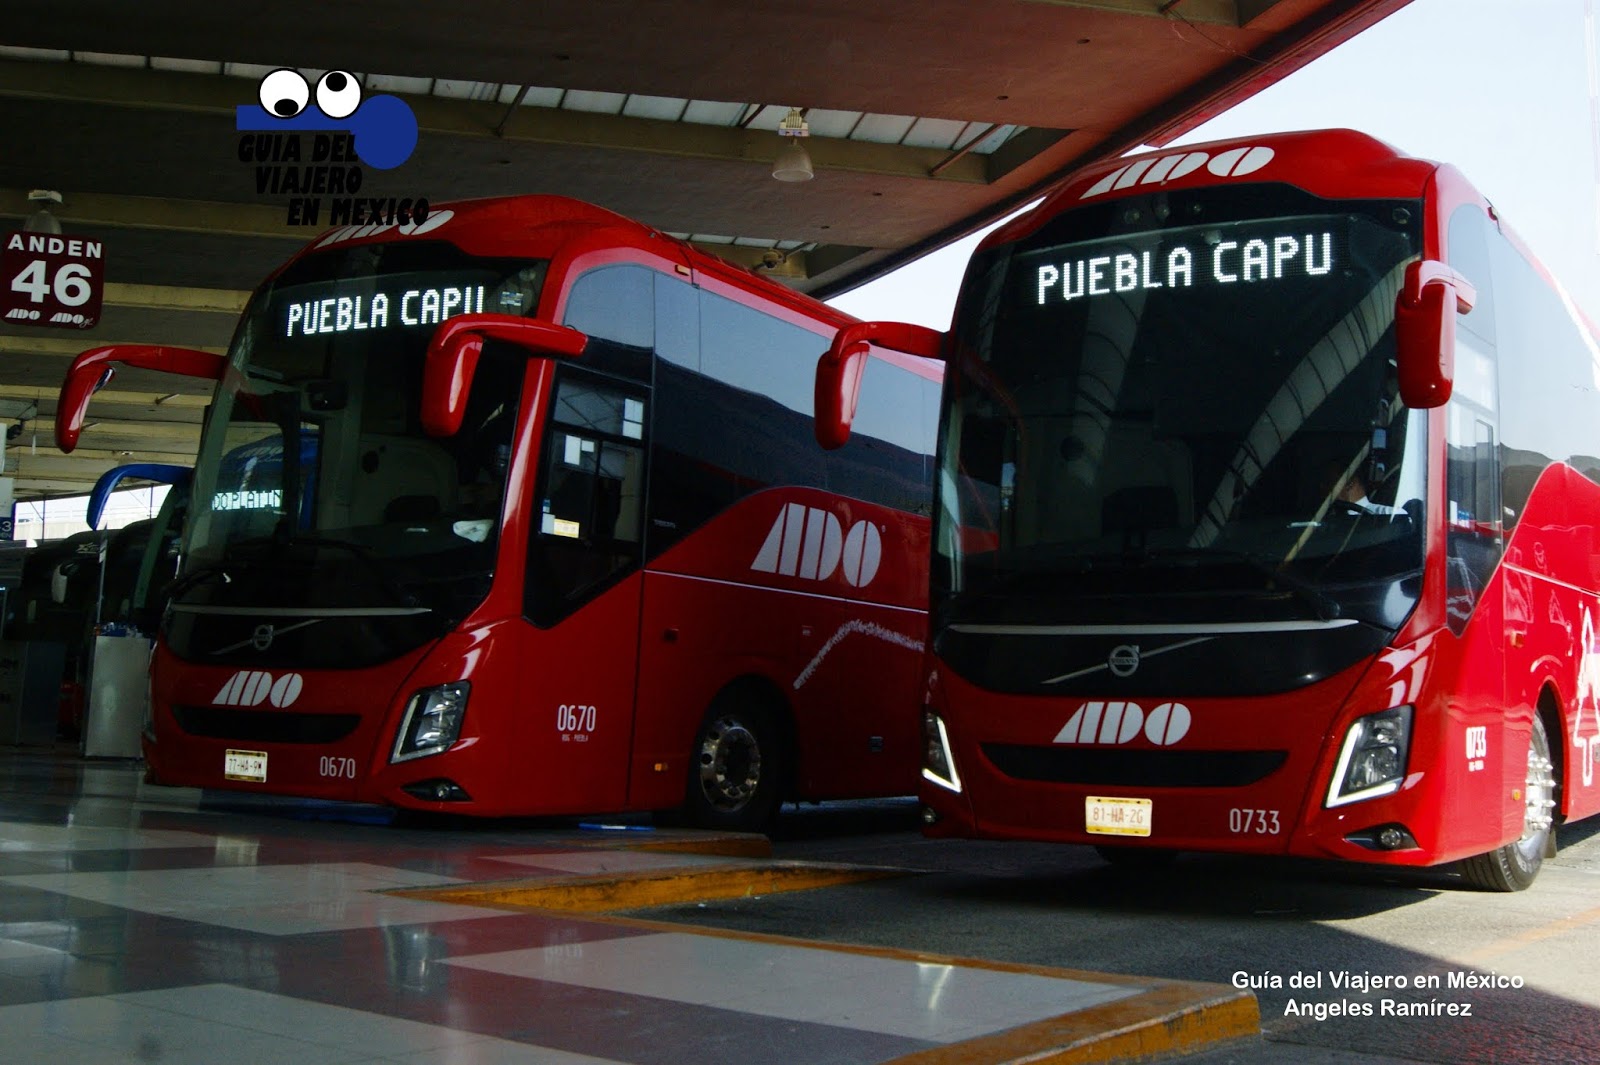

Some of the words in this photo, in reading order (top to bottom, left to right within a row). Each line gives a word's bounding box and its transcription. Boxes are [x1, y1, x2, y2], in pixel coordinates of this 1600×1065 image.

[1080, 147, 1275, 199] ADO
[7, 233, 102, 259] ANDEN
[11, 259, 92, 307] 46
[1038, 246, 1193, 305] PUEBLA
[1213, 231, 1333, 284] CAPU
[5, 308, 41, 321] ADO
[286, 293, 390, 337] PUEBLA
[750, 502, 883, 588] ADO
[211, 670, 304, 709] ADO
[557, 704, 597, 732] 0670
[1052, 701, 1193, 746] ADO
[319, 756, 356, 779] 0670
[1228, 808, 1281, 835] 0733
